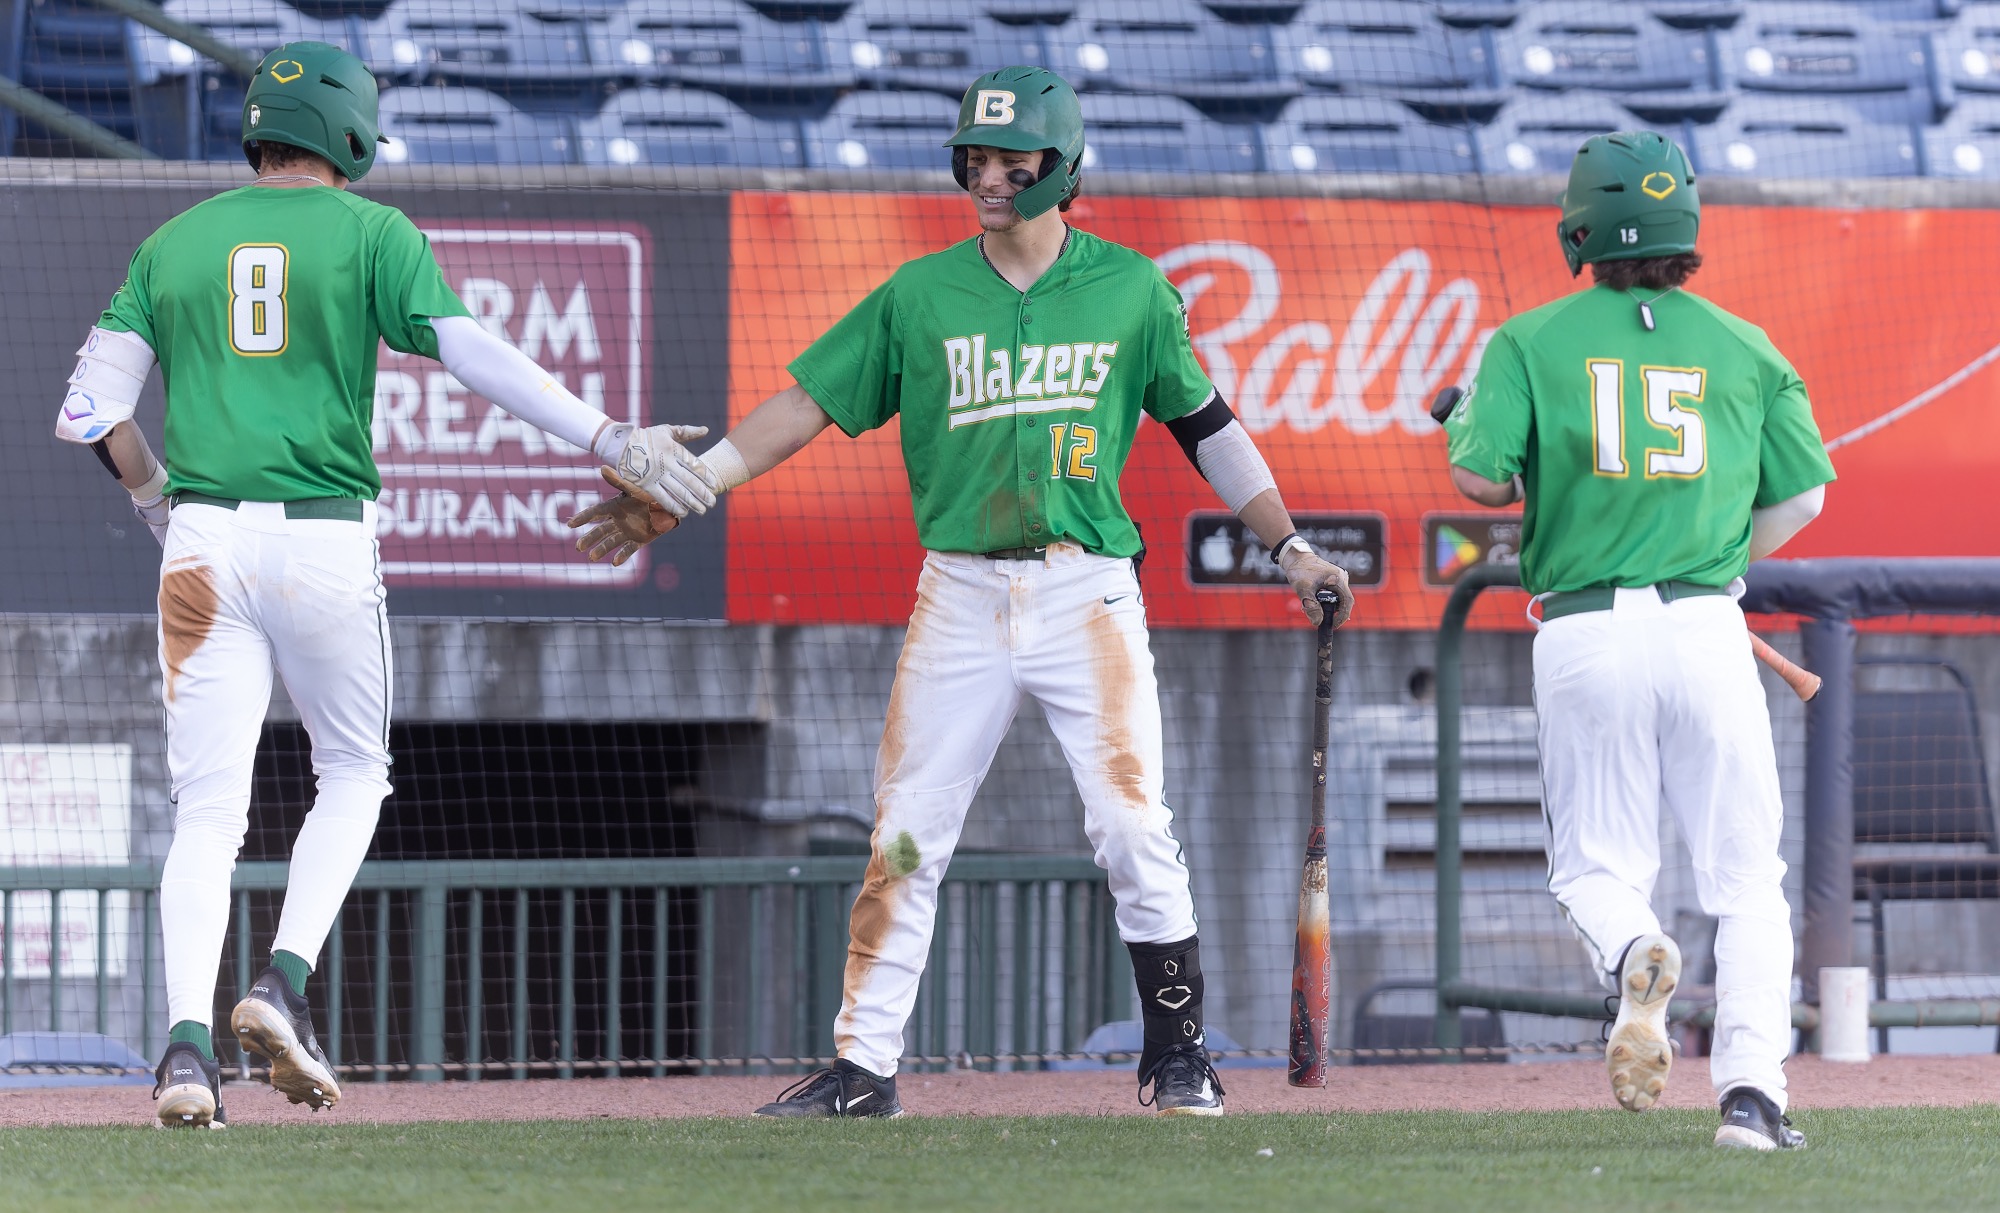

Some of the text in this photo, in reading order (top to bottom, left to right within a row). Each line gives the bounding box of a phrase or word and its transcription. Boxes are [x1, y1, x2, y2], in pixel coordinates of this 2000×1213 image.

[1620, 228, 1638, 244] 15
[228, 243, 289, 357] 8
[1138, 239, 1497, 437] Ball
[943, 333, 1119, 411] Blazers
[1050, 422, 1097, 482] 12
[1586, 358, 1707, 480] 15
[376, 487, 602, 540] SURANCE
